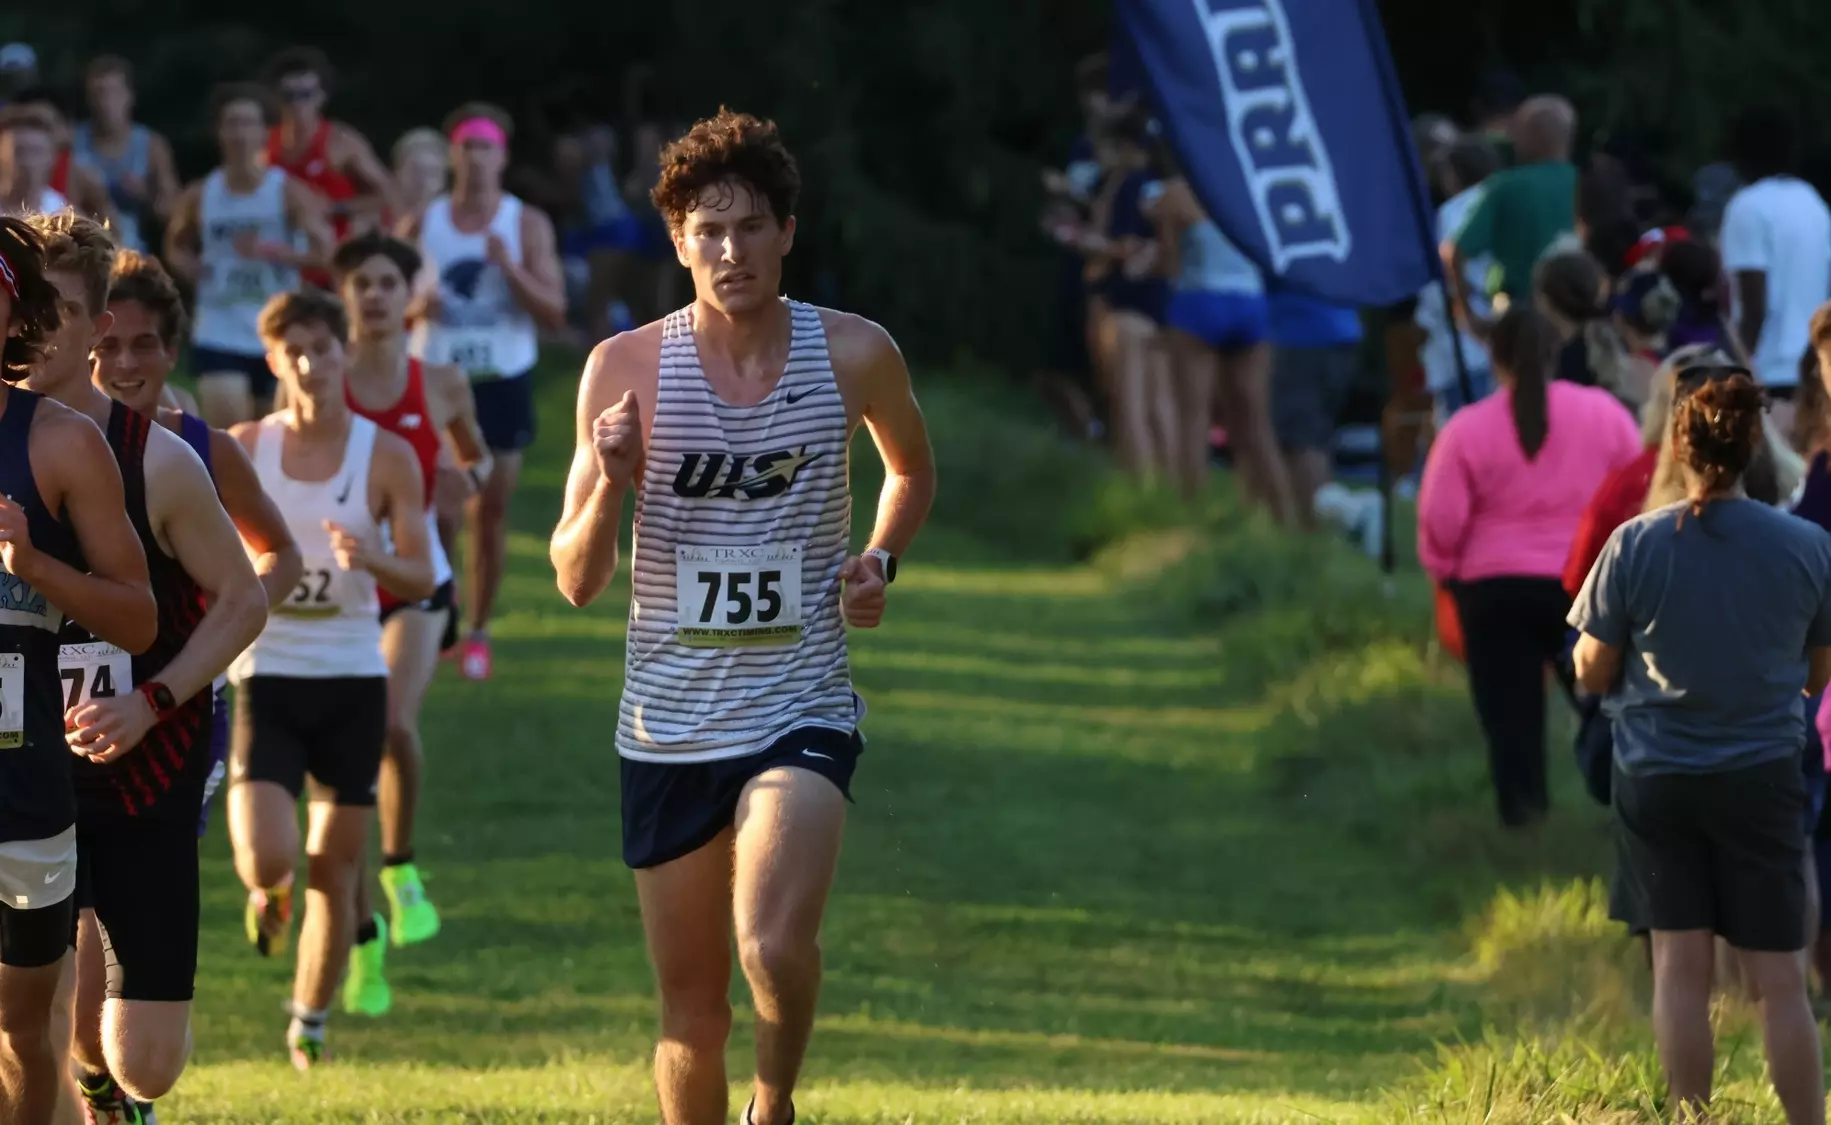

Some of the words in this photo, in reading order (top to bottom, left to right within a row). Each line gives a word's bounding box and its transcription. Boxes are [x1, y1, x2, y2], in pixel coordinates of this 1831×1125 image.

[672, 448, 806, 499] UIS
[710, 548, 765, 559] TRXC
[698, 570, 782, 624] 755
[683, 625, 798, 637] WWW.TRXCTIMING.COM
